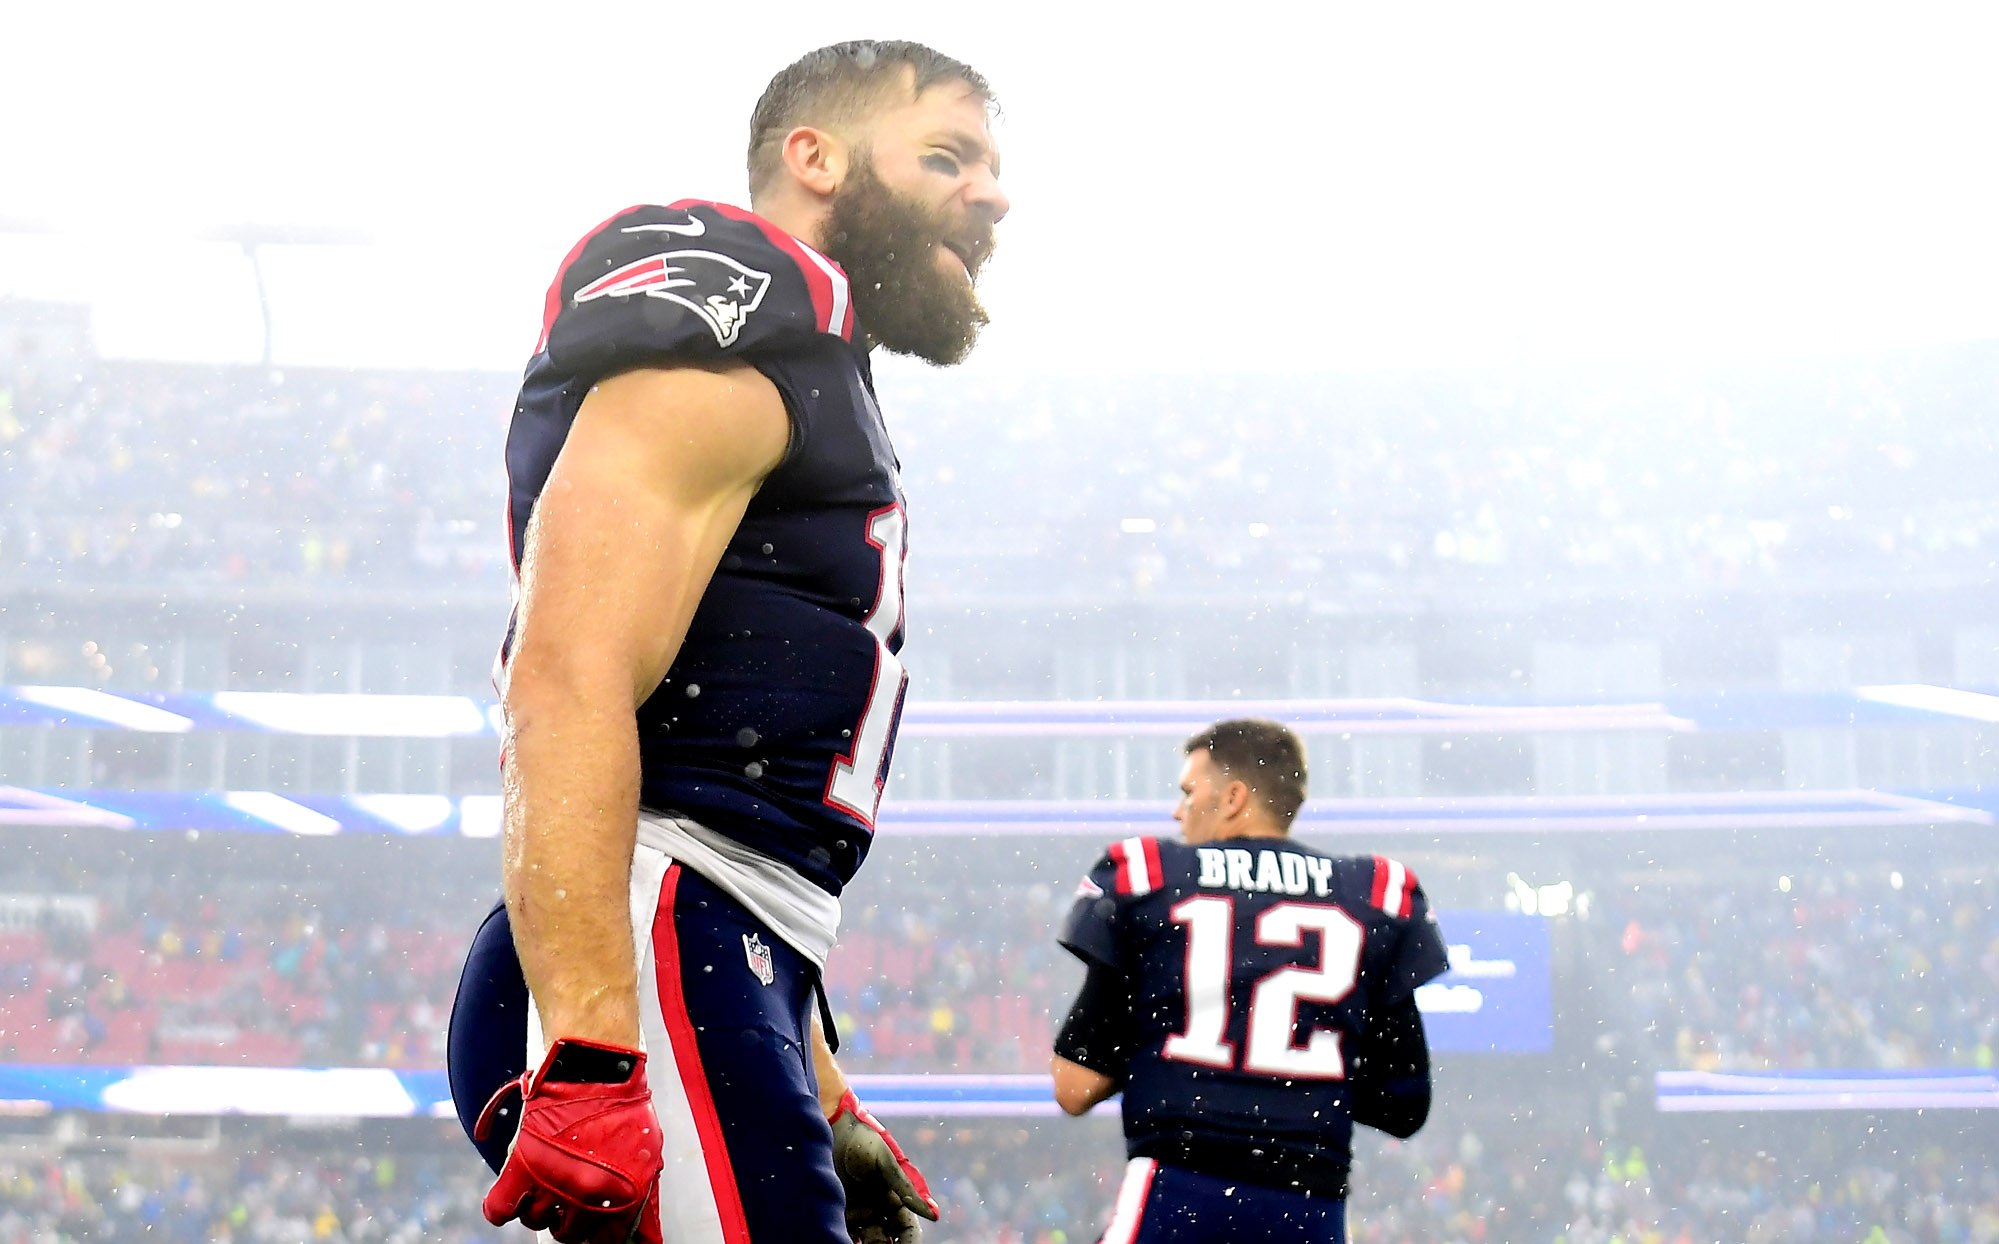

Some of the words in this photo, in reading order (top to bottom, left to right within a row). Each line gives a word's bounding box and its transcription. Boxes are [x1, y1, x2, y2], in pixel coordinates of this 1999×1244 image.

[1196, 848, 1333, 897] BRADY
[752, 953, 770, 977] NFL
[1162, 893, 1365, 1082] 12
